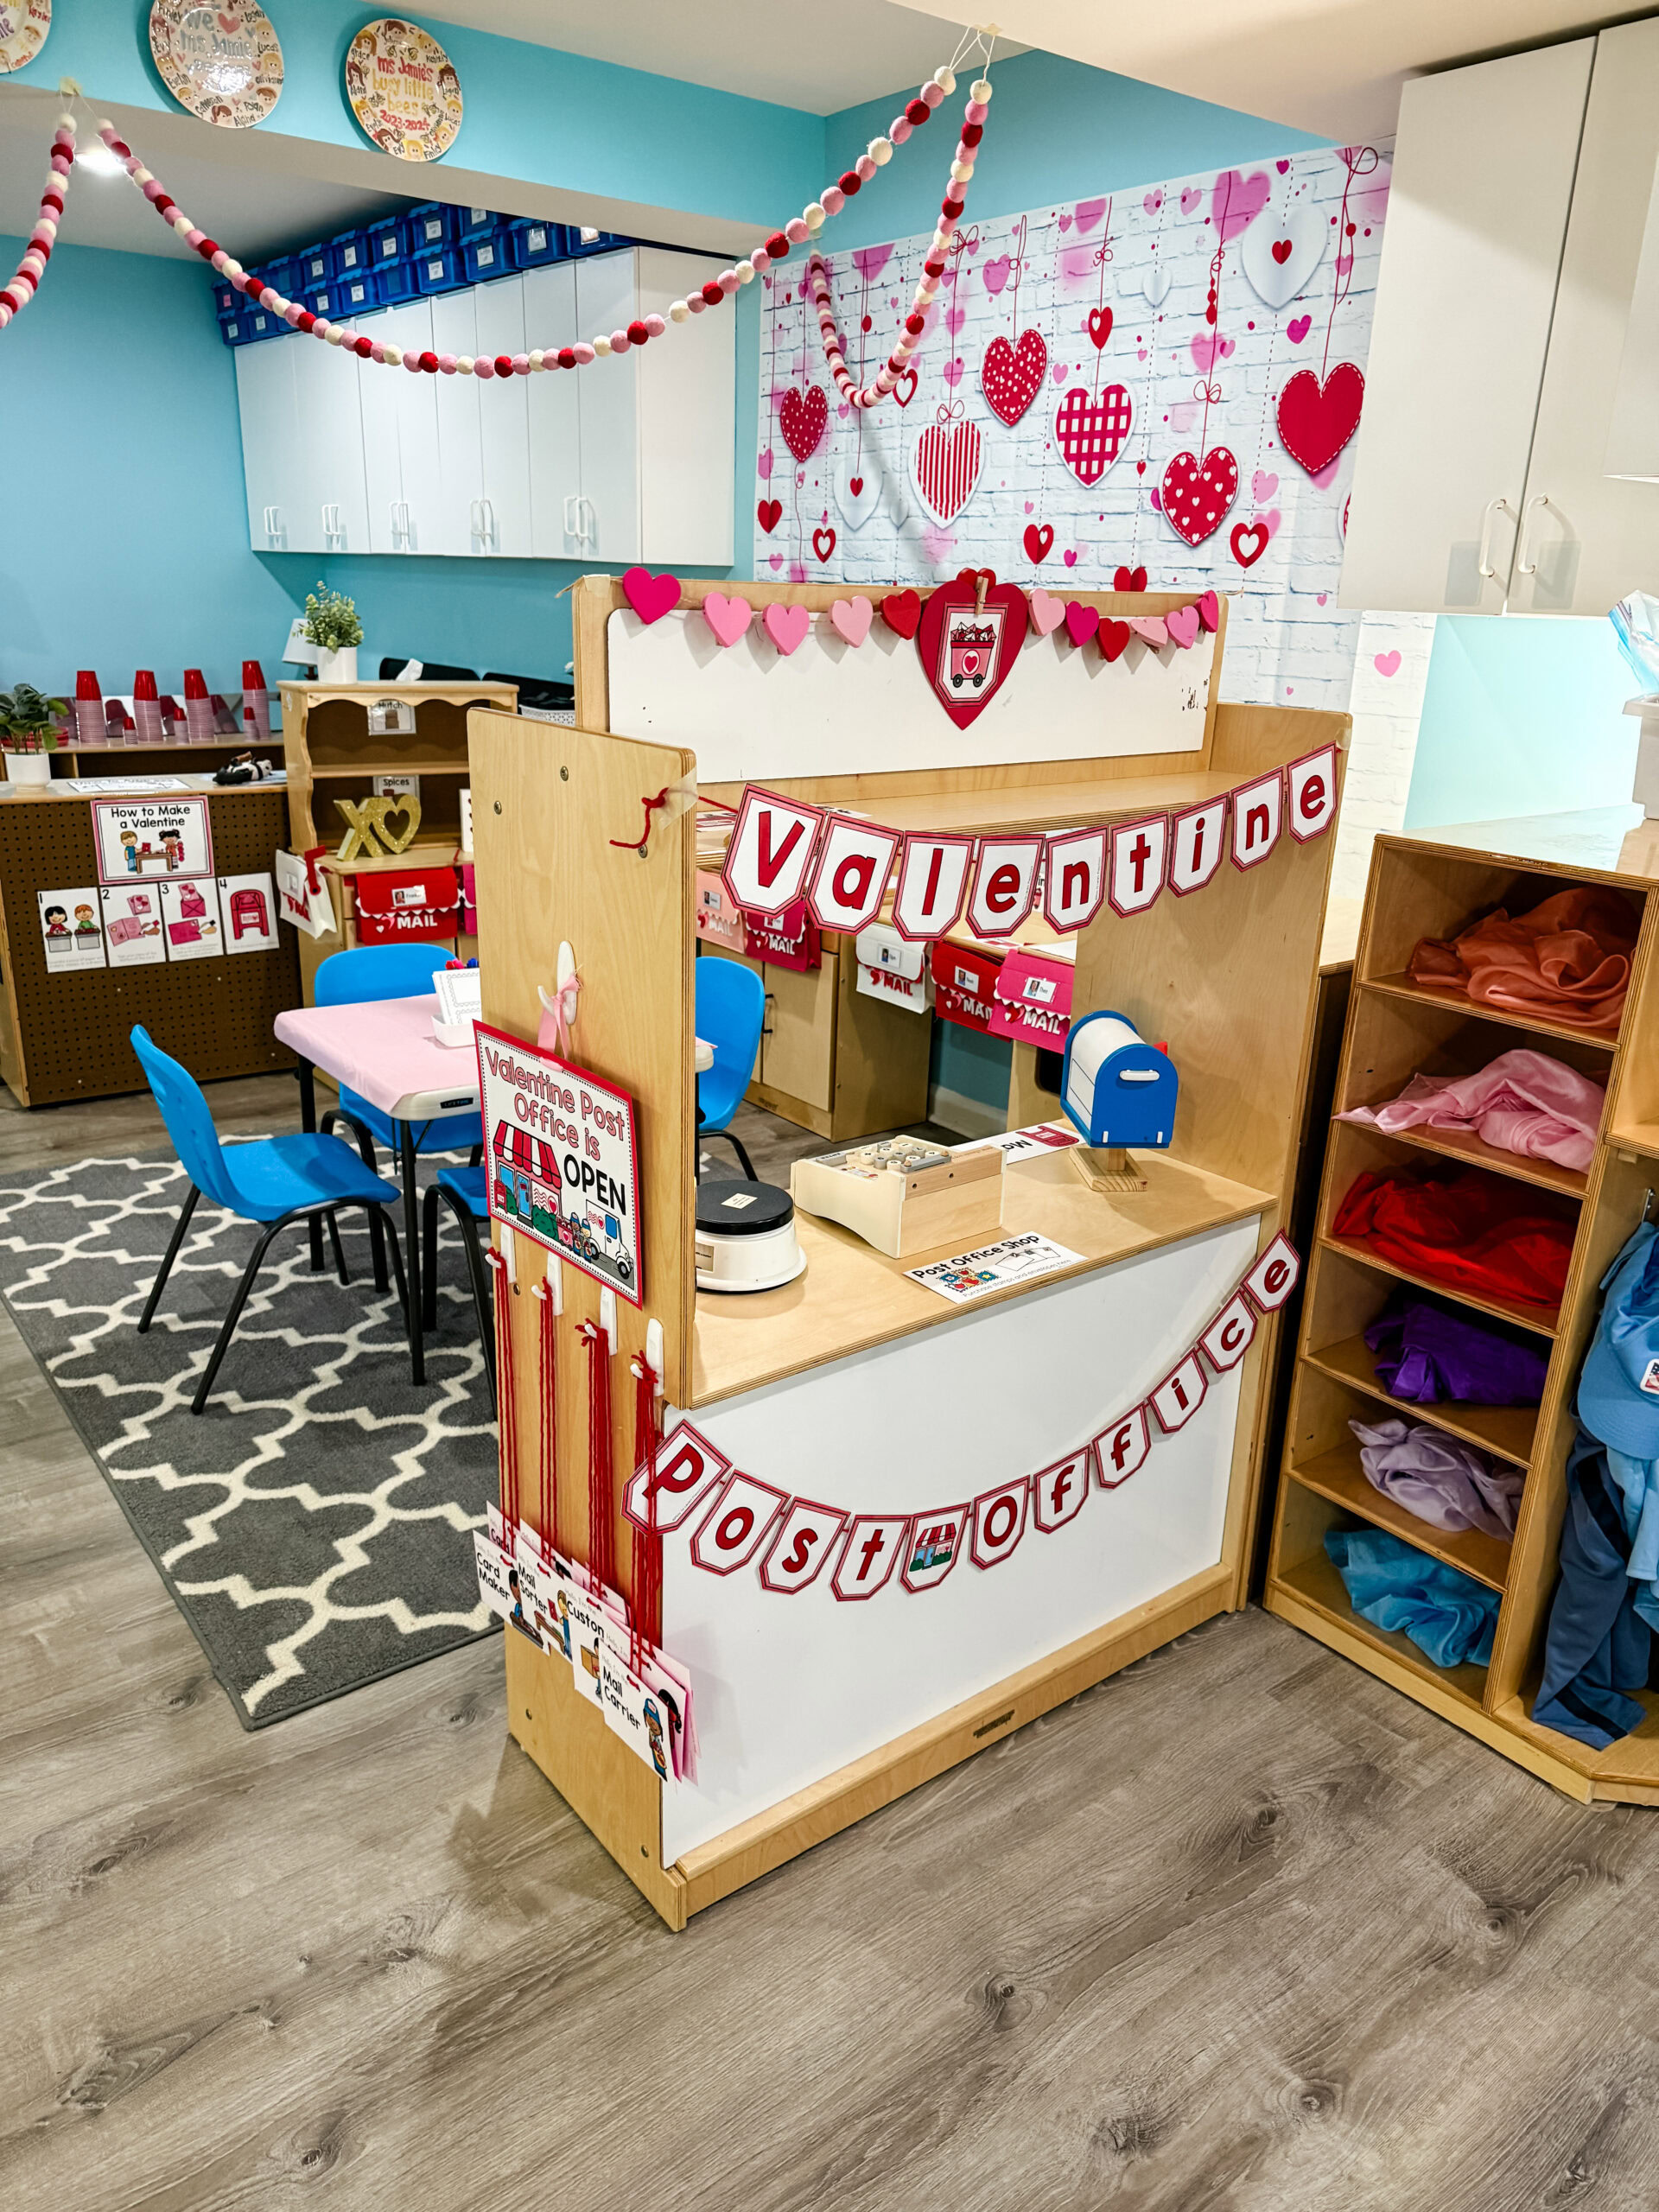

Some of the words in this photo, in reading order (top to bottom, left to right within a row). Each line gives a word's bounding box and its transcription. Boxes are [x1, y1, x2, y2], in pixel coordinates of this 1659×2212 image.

[187, 10, 214, 31] We
[404, 78, 434, 100] little
[383, 779, 410, 787] Spices
[111, 808, 137, 818] How
[142, 808, 155, 817] to
[158, 805, 191, 816] Make
[131, 817, 185, 829] Valentine
[757, 773, 1326, 917] Valentine
[102, 889, 110, 899] 2
[162, 884, 169, 894] 3
[219, 879, 227, 888] 4
[397, 915, 437, 930] MAIL
[709, 917, 734, 937] MAIL
[769, 935, 795, 956] MAIL
[883, 974, 913, 996] MAIL
[1023, 1011, 1060, 1035] MAIL
[485, 1046, 575, 1114] Valentine
[580, 1090, 625, 1141] Post
[514, 1092, 579, 1148] Office
[584, 1128, 601, 1160] is
[564, 1154, 626, 1216] OPEN
[912, 1262, 951, 1279] Post
[950, 1246, 1003, 1267] Office
[1001, 1235, 1039, 1250] Shop
[642, 1442, 885, 1580] Post
[982, 1259, 1290, 1548] Office
[476, 1552, 500, 1580] Card
[518, 1562, 537, 1589] Mail
[479, 1568, 511, 1600] Maker
[519, 1580, 548, 1614] Sorter
[603, 1665, 623, 1698] Mail
[605, 1685, 641, 1730] Carrier
